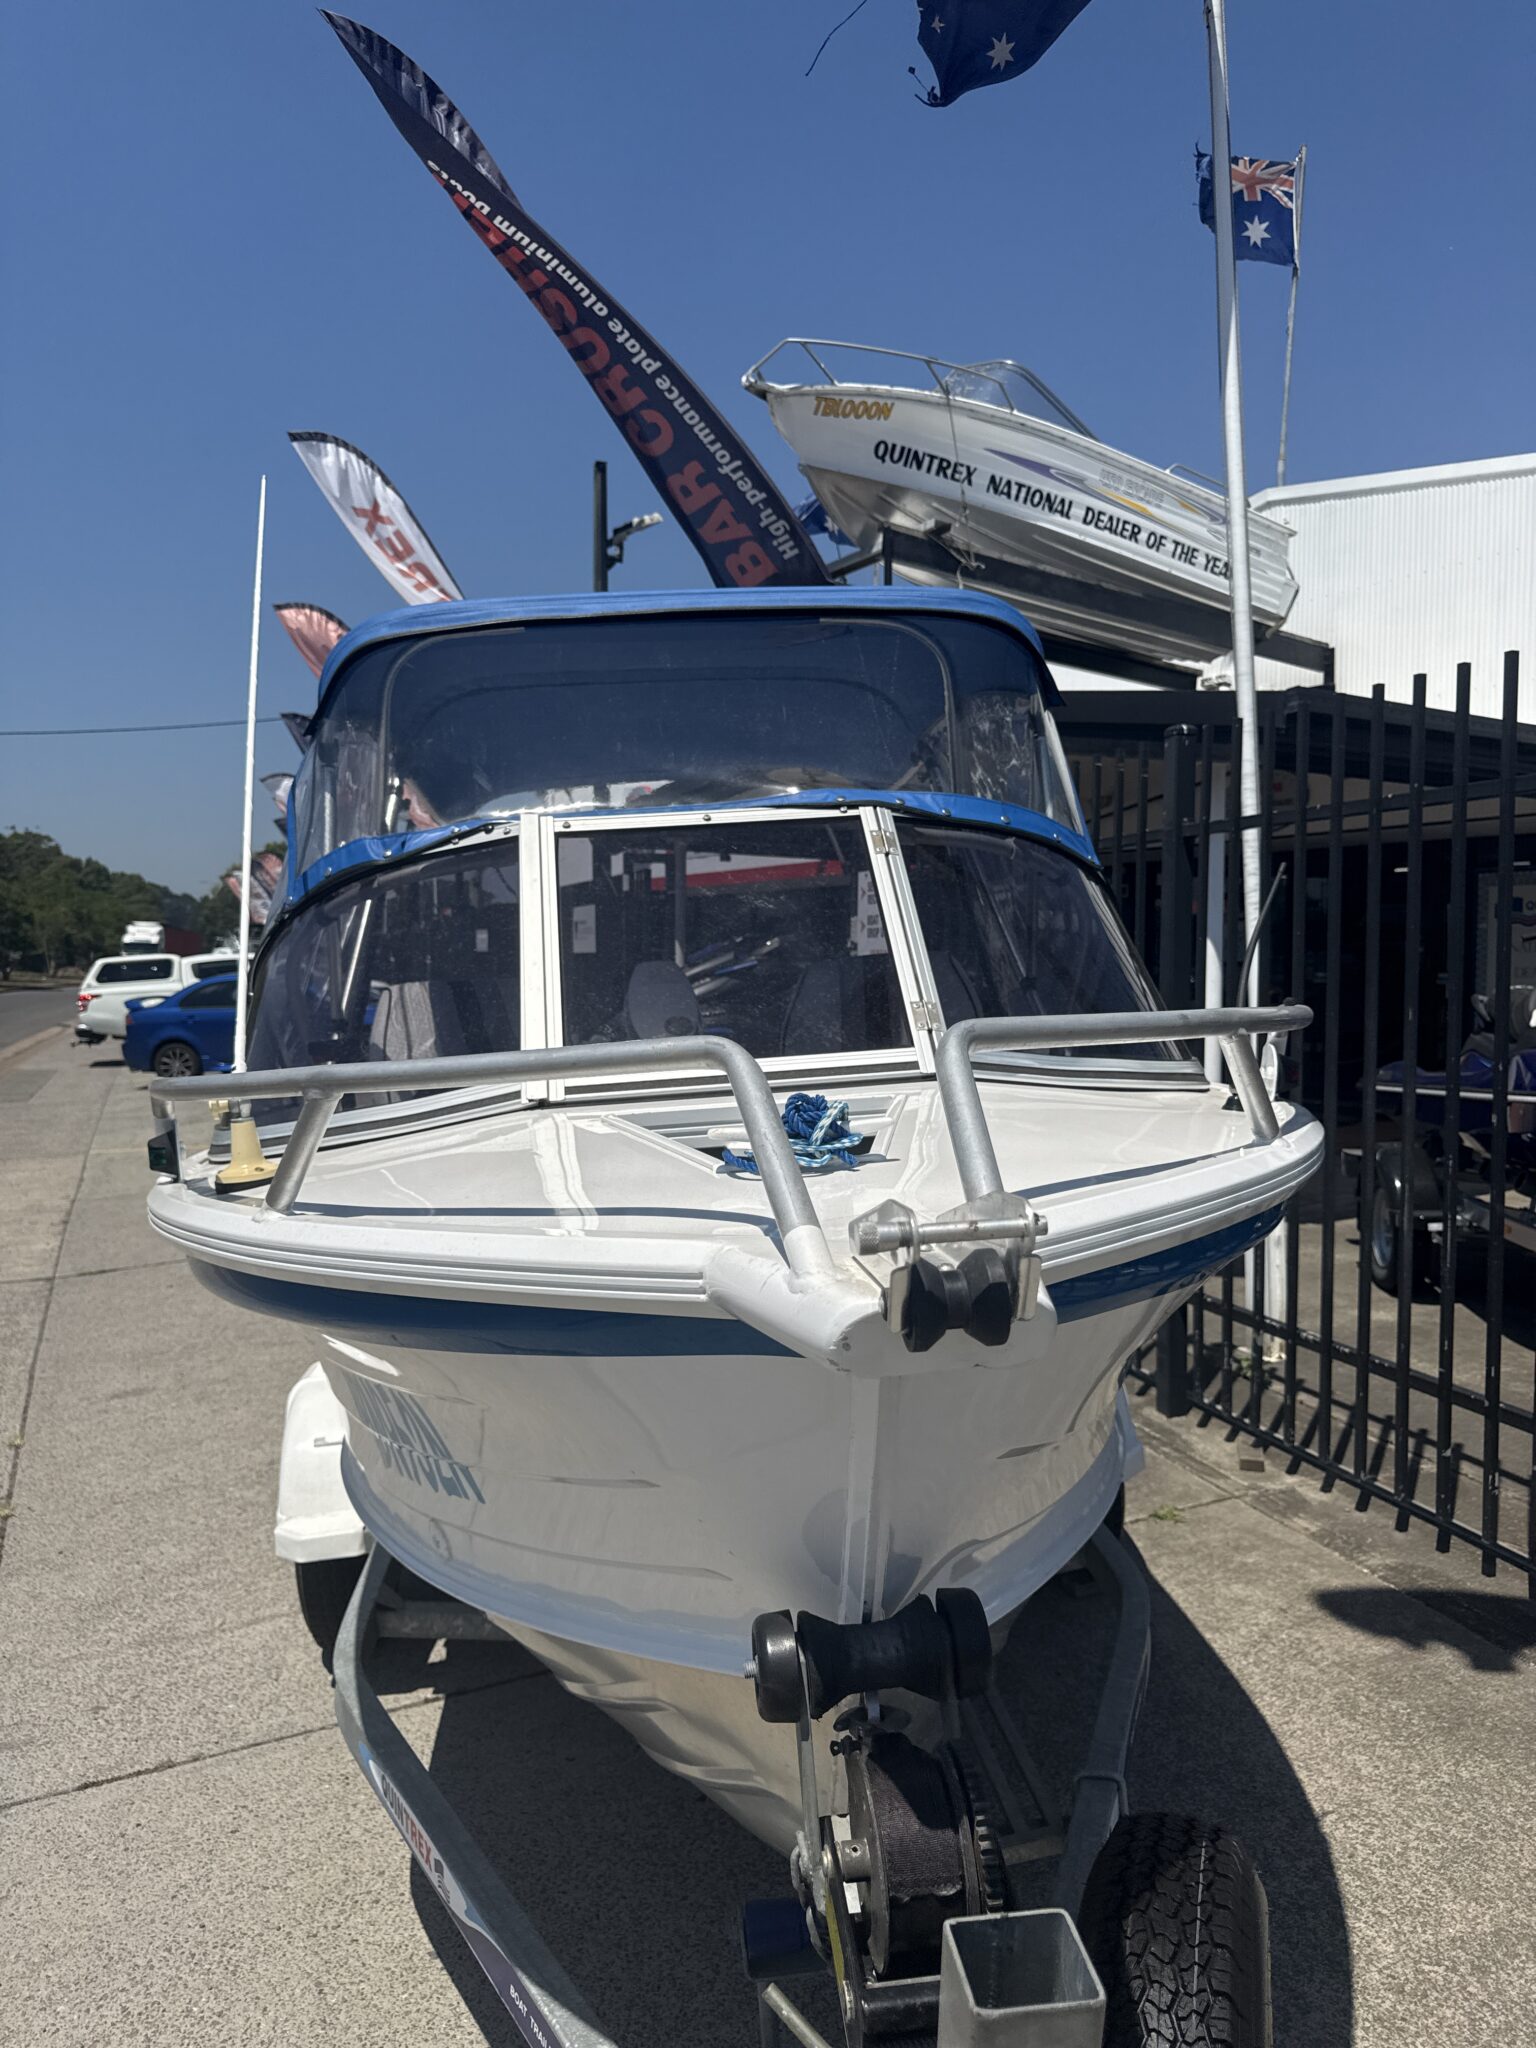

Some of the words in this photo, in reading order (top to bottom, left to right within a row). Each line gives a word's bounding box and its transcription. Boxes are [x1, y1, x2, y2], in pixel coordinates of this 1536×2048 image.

[492, 214, 609, 318] aluminium
[607, 317, 662, 375] plate
[655, 375, 799, 560] High-performance
[873, 440, 977, 487] QUINTREX
[986, 474, 1074, 520] NATIONAL
[1082, 507, 1142, 543] DEALER
[1145, 531, 1167, 554] OF
[1171, 539, 1199, 566] THE
[1204, 553, 1232, 580] YEA
[667, 460, 779, 587] BAR
[381, 1773, 432, 1872] QUINTREX
[509, 1984, 528, 2017] BOAT
